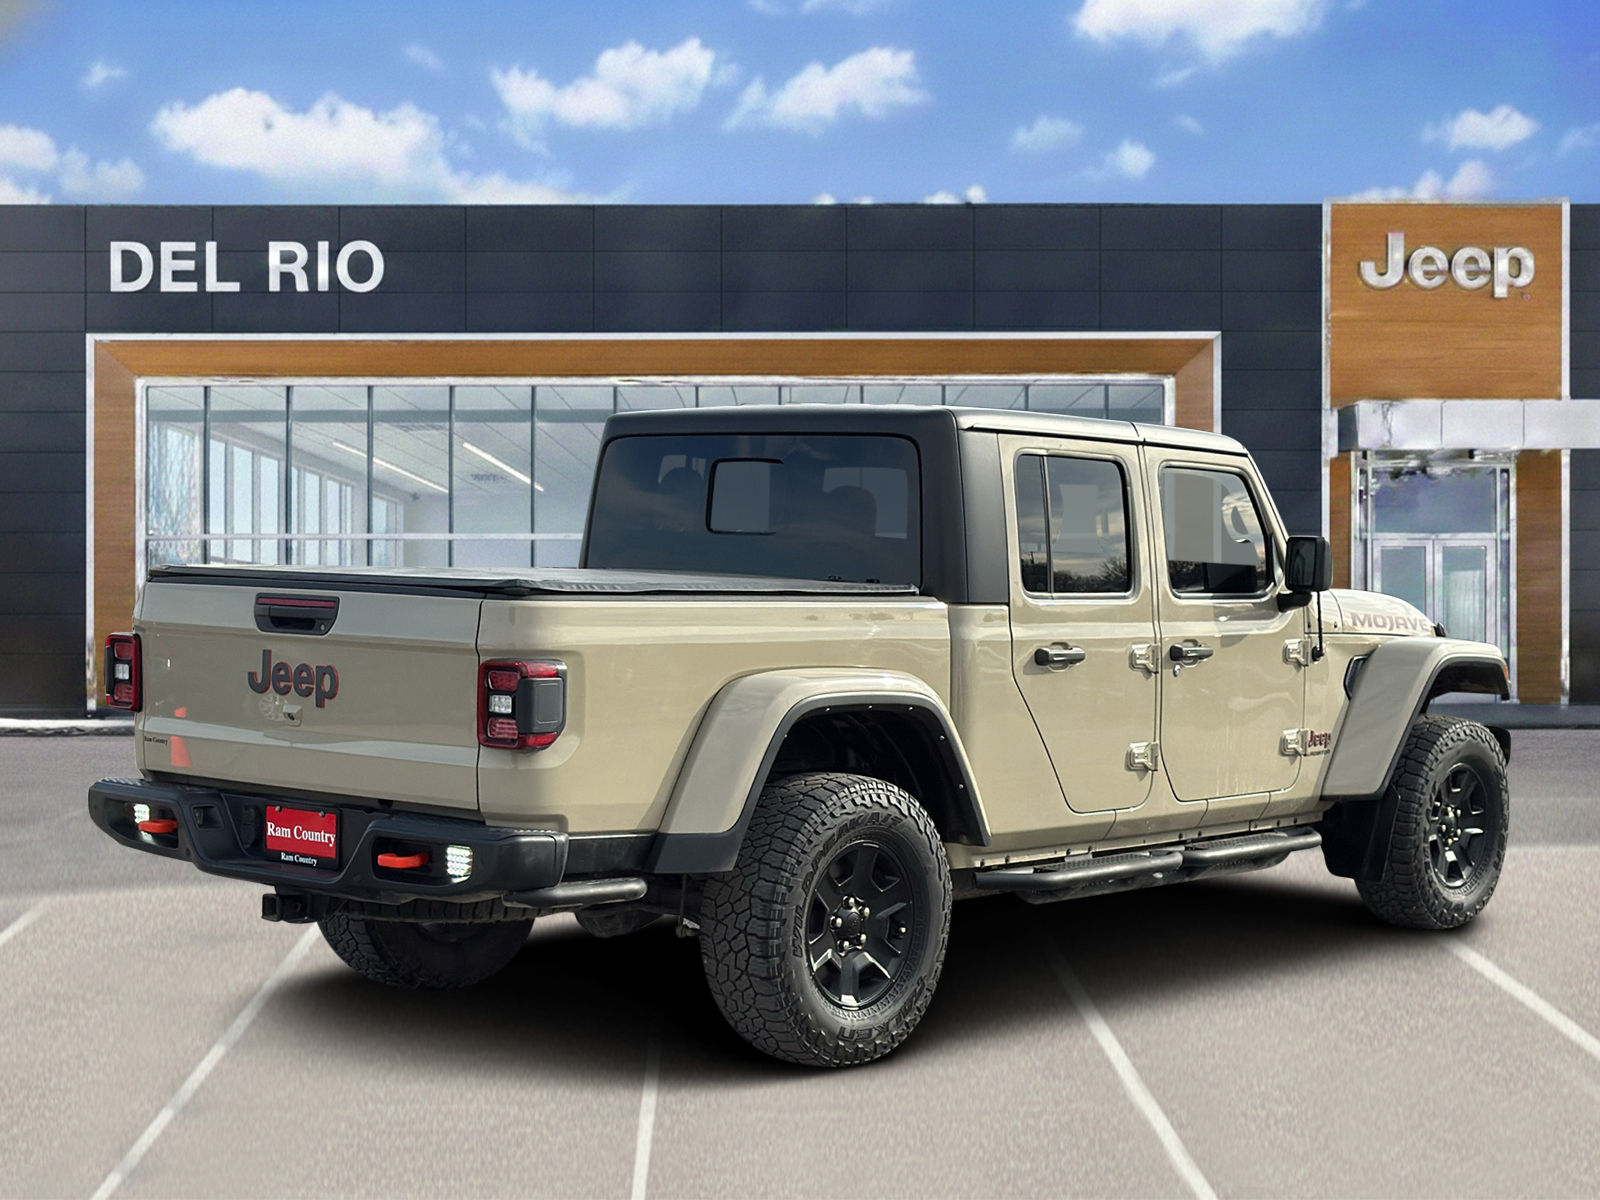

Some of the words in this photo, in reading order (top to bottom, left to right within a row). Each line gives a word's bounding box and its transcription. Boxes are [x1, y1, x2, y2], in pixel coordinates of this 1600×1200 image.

[109, 241, 241, 293] DEL
[268, 240, 385, 293] RIO
[1359, 231, 1535, 299] Jeep
[1350, 611, 1432, 632] MOJAVE
[247, 648, 340, 709] Jeep
[1307, 730, 1332, 749] Jeep
[266, 821, 292, 839] Ram
[293, 825, 337, 849] Country
[280, 851, 295, 863] Ram
[294, 854, 319, 868] Country
